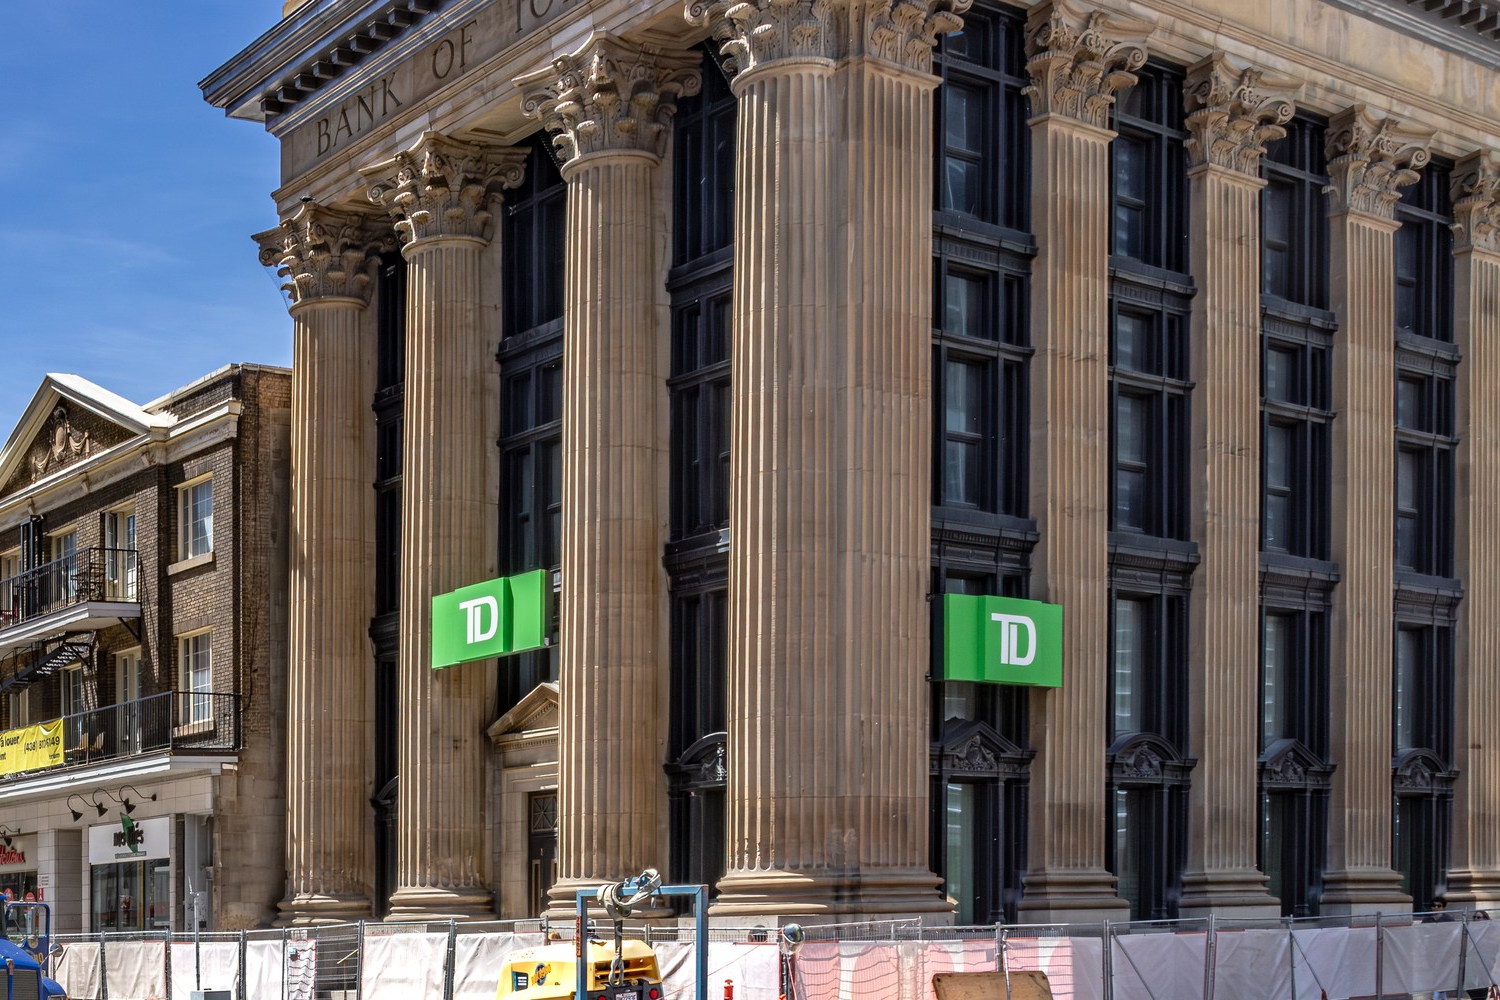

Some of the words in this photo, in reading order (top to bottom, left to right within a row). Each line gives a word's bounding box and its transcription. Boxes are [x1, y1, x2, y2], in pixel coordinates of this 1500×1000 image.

[317, 72, 403, 157] BANK
[432, 19, 477, 79] OF
[459, 595, 499, 645] TD
[991, 612, 1037, 666] TD
